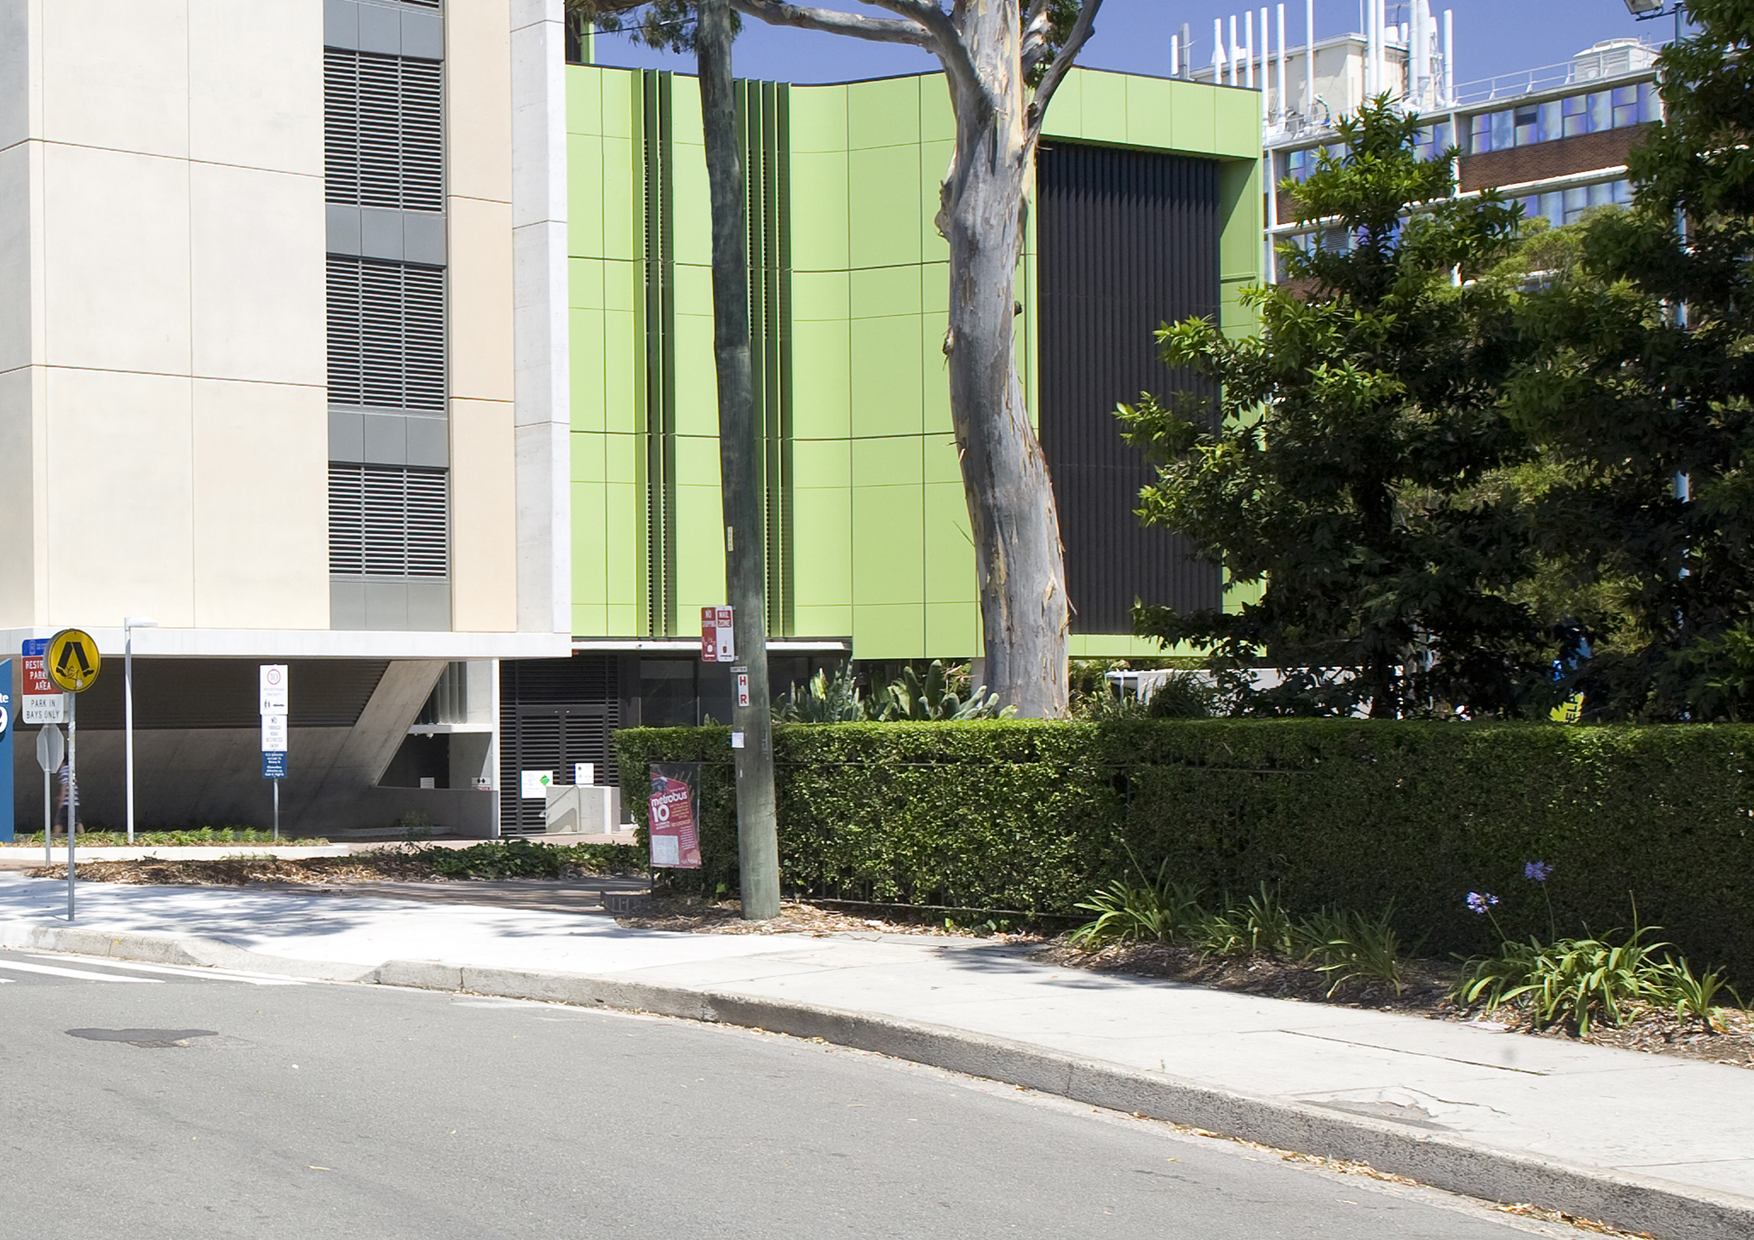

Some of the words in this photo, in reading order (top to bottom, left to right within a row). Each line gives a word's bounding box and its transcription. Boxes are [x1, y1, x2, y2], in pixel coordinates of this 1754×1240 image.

[35, 681, 51, 690] AREA
[30, 699, 46, 707] PARK
[49, 699, 56, 707] IN
[26, 710, 42, 719] BAYS
[44, 710, 60, 719] ONLY
[651, 792, 688, 807] metrobus
[652, 804, 670, 823] 10
